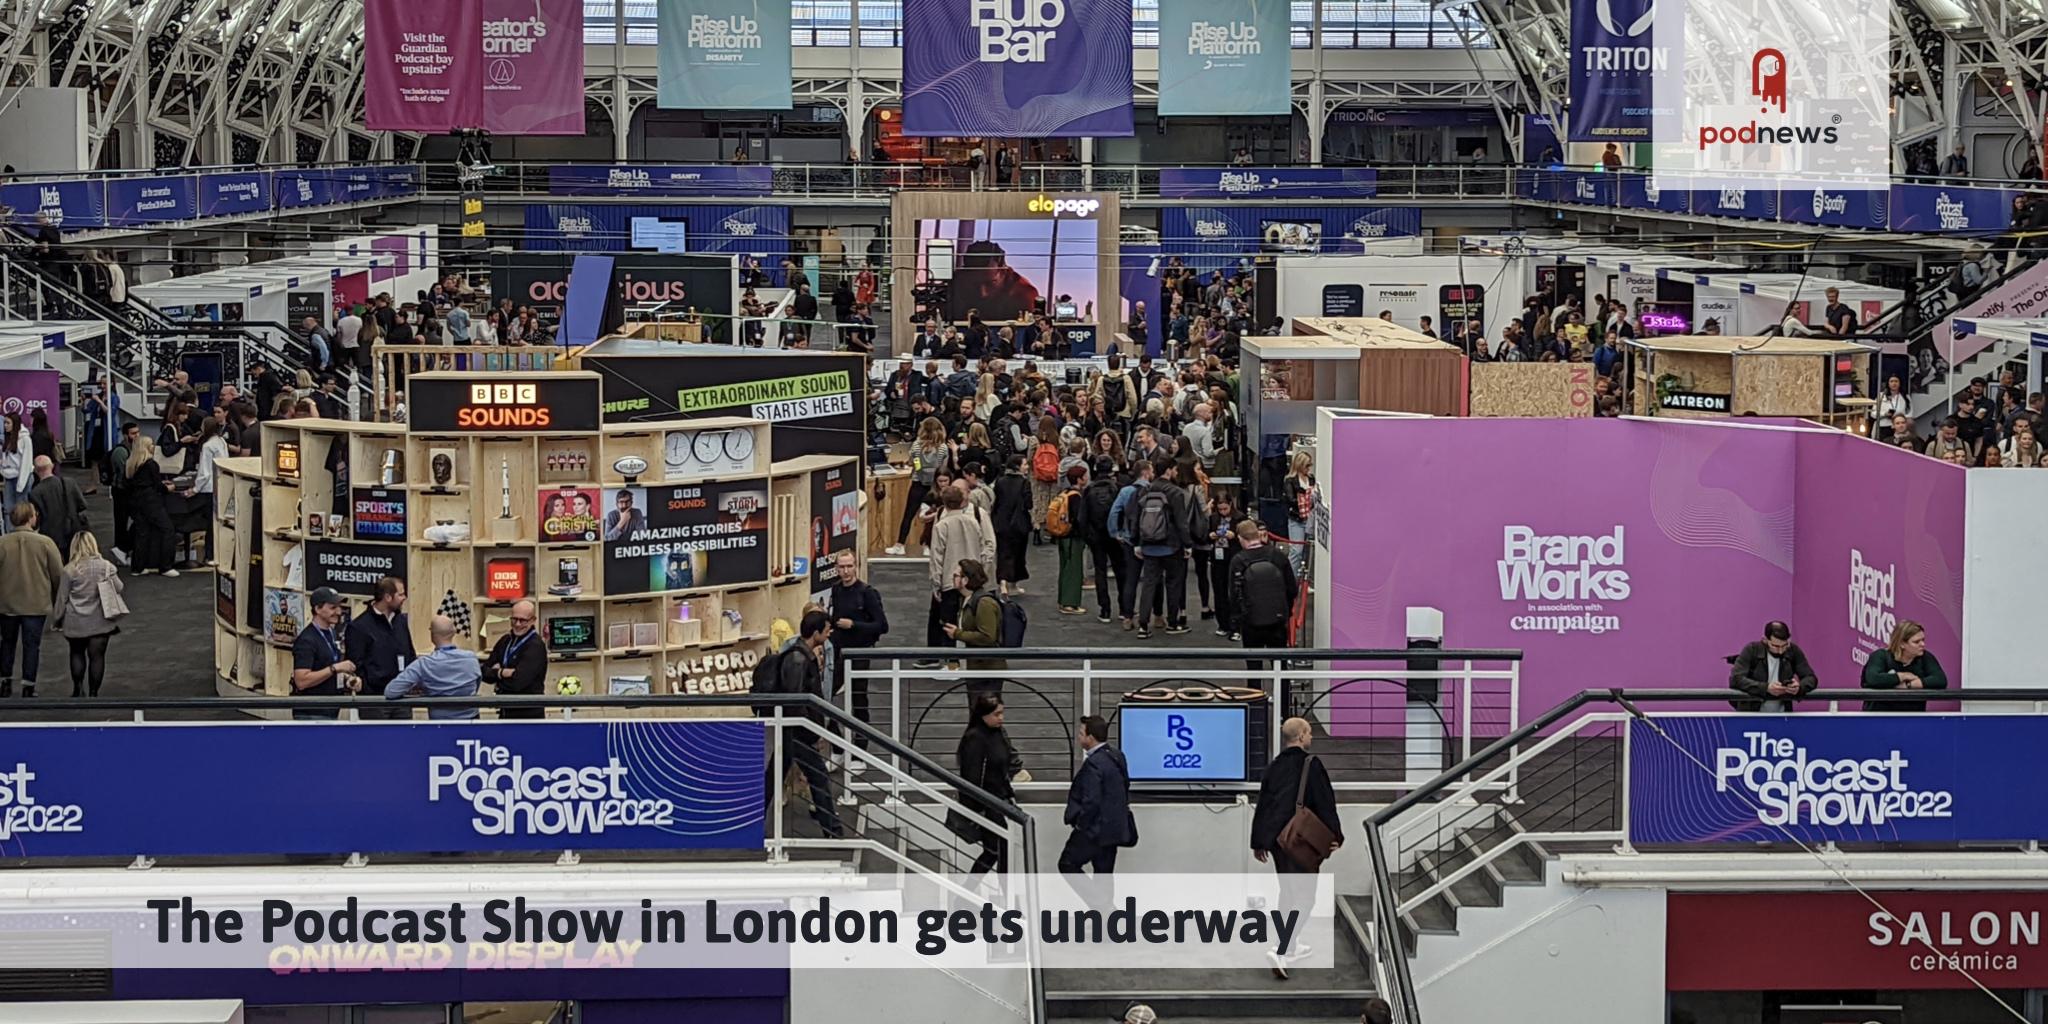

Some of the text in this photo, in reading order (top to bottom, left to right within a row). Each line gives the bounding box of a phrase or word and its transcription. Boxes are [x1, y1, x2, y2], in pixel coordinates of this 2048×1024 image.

[482, 16, 546, 38] eator's
[691, 15, 758, 37] Rise Up
[1191, 22, 1258, 43] Rise Up
[401, 43, 447, 53] Guardian
[403, 33, 445, 43] Visit the
[482, 37, 536, 54] orner
[688, 29, 762, 49] Platform
[979, 19, 1057, 63] Bar
[1187, 36, 1262, 55] Platform
[395, 55, 454, 67] Podcast bay
[1582, 47, 1668, 71] TRITON
[609, 169, 650, 183] Rise Up
[1221, 171, 1260, 184] Rise Up
[1028, 194, 1100, 217] elopage
[723, 219, 757, 231] Podcast
[2011, 298, 2035, 315] The
[471, 383, 537, 404] BBC
[683, 374, 848, 408] EXTRAORDINARY SOUND
[1663, 394, 1725, 409] PATREON
[26, 400, 48, 409] 4DC
[756, 395, 848, 421] STARTS HERE
[458, 407, 551, 427] SOUNDS
[356, 501, 405, 515] SPORT'S
[667, 498, 707, 510] SOUNDS
[356, 521, 405, 536] CRIMES
[544, 517, 598, 535] CHRISTIE
[630, 521, 743, 542] AMAZING STORIES
[614, 535, 758, 559] ENDLESS POSSIBILITIES
[1503, 525, 1625, 566] Brand
[319, 553, 393, 569] BBC SOUNDS
[326, 569, 386, 584] PRESENTS
[491, 580, 521, 590] NEWS
[1496, 559, 1631, 601] Works
[1850, 548, 1895, 609] Brand
[1528, 603, 1603, 611] In association with
[1848, 584, 1896, 646] Works
[1510, 612, 1620, 634] campaign
[665, 649, 758, 678] SALFORD
[456, 738, 511, 766] The
[1743, 731, 1795, 758] The
[1163, 753, 1202, 768] 2022
[1716, 747, 1909, 794] Podcast
[429, 754, 629, 803] Podcast
[472, 788, 675, 835] Show 2022
[1757, 780, 1953, 826] Show 2022
[11, 804, 84, 833] 2022
[268, 939, 645, 975] ONWARD DISPLAY
[1909, 949, 2018, 972] cerámica
